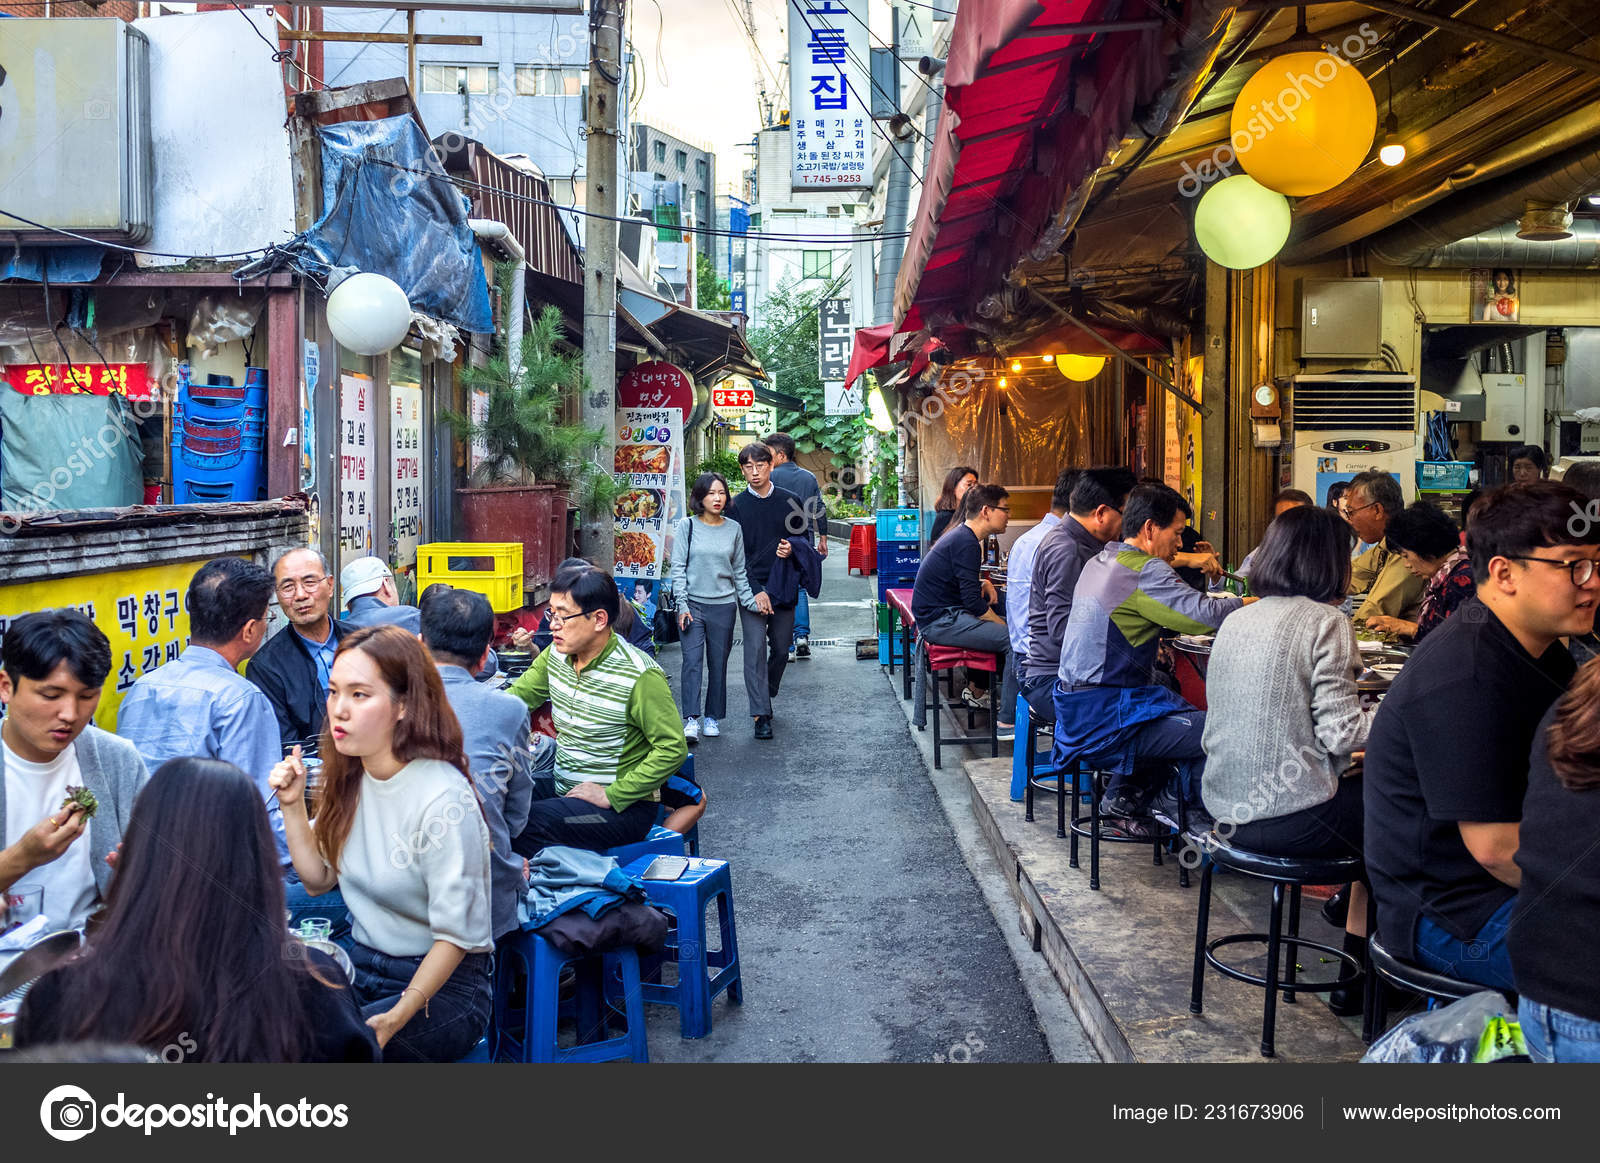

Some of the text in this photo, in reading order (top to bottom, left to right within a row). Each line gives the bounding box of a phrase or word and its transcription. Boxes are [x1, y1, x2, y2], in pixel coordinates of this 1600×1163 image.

[803, 174, 861, 183] T.745-9253
[714, 391, 752, 405] 칼국수
[341, 456, 365, 480] 매기살
[117, 590, 191, 638] 막창구
[117, 638, 191, 691] 소갈비
